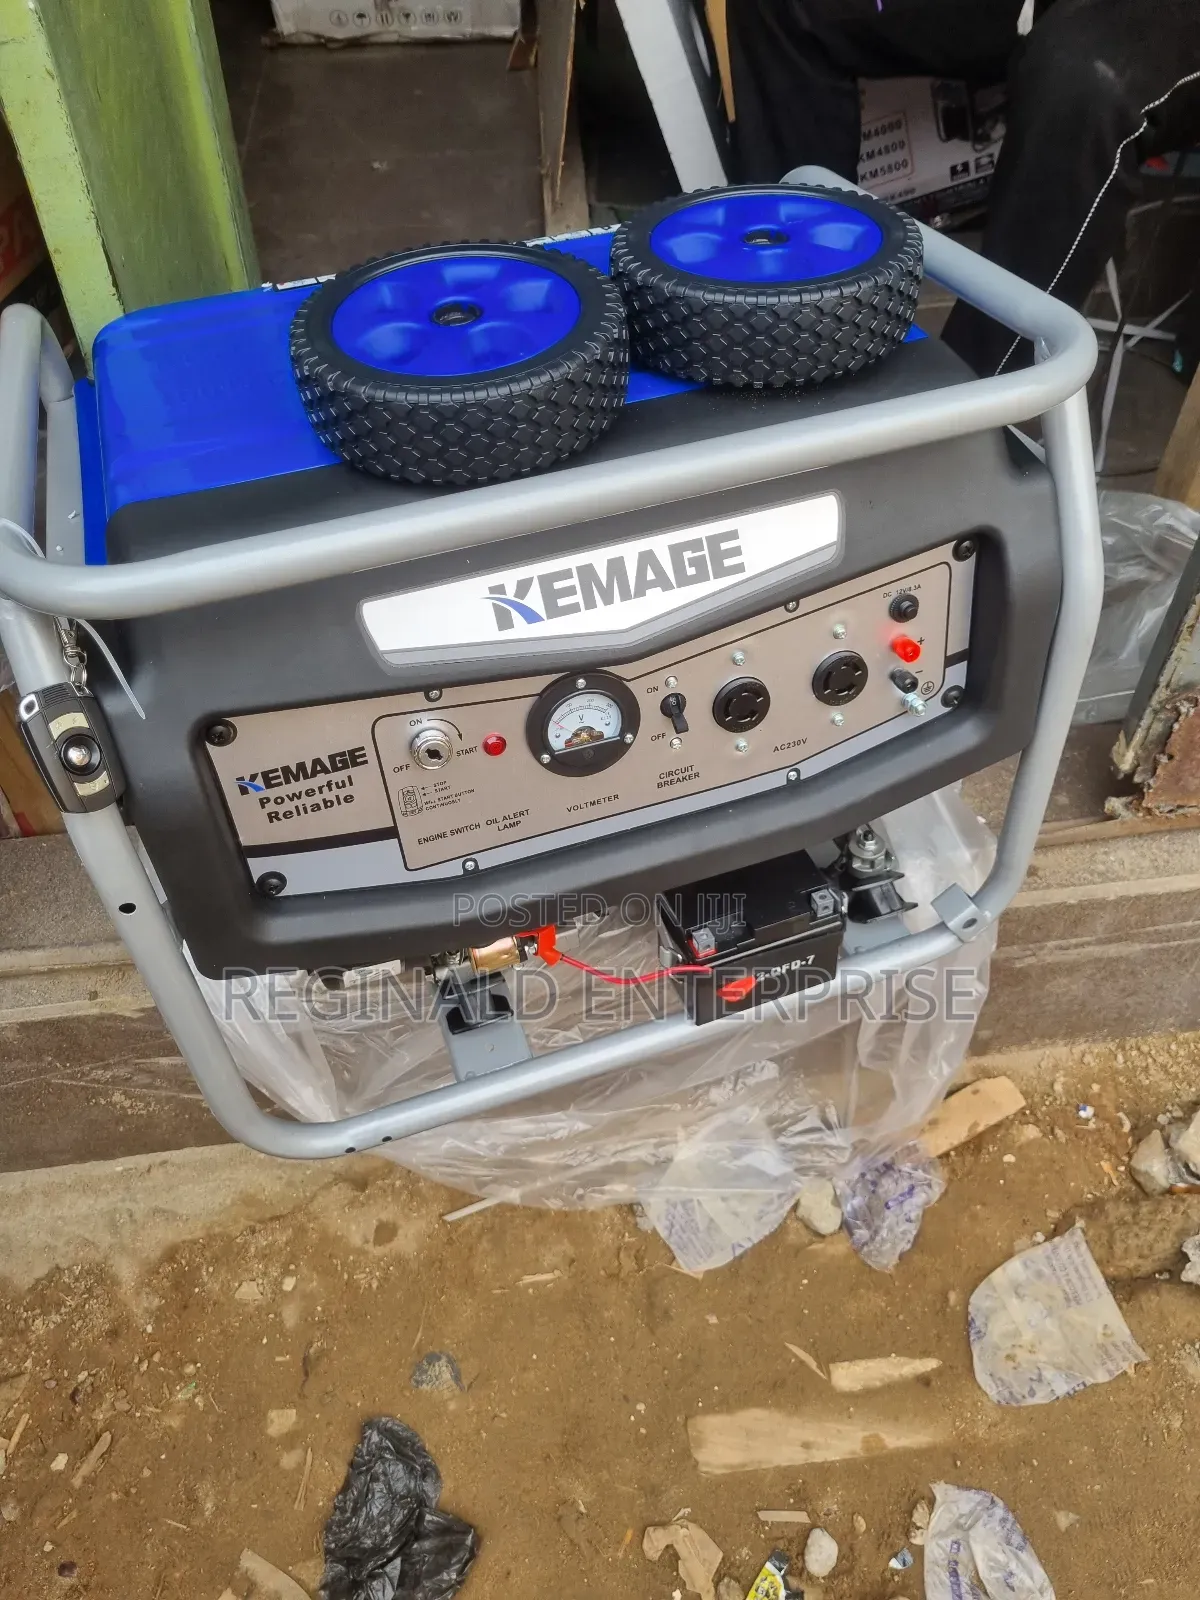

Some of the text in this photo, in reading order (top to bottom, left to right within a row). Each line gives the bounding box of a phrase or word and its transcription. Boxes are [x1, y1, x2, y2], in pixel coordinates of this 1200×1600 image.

[480, 528, 746, 632] KEMAGE
[882, 591, 893, 599] DC
[646, 685, 659, 694] ON
[409, 718, 423, 727] ON
[650, 732, 667, 742] OFF
[772, 737, 808, 753] AC230V
[456, 746, 478, 757] START
[234, 746, 369, 796] KEMAGE
[392, 763, 411, 774] OFF
[658, 765, 695, 780] CIRCUIT
[656, 771, 701, 789] BREAKER
[258, 775, 354, 810] Powerful
[266, 792, 356, 824] Reliable
[566, 793, 620, 813] VOLTMETER
[485, 809, 530, 826] OIL ALERT
[417, 822, 481, 846] ENGINE SWITCH
[497, 820, 522, 832] LAMP
